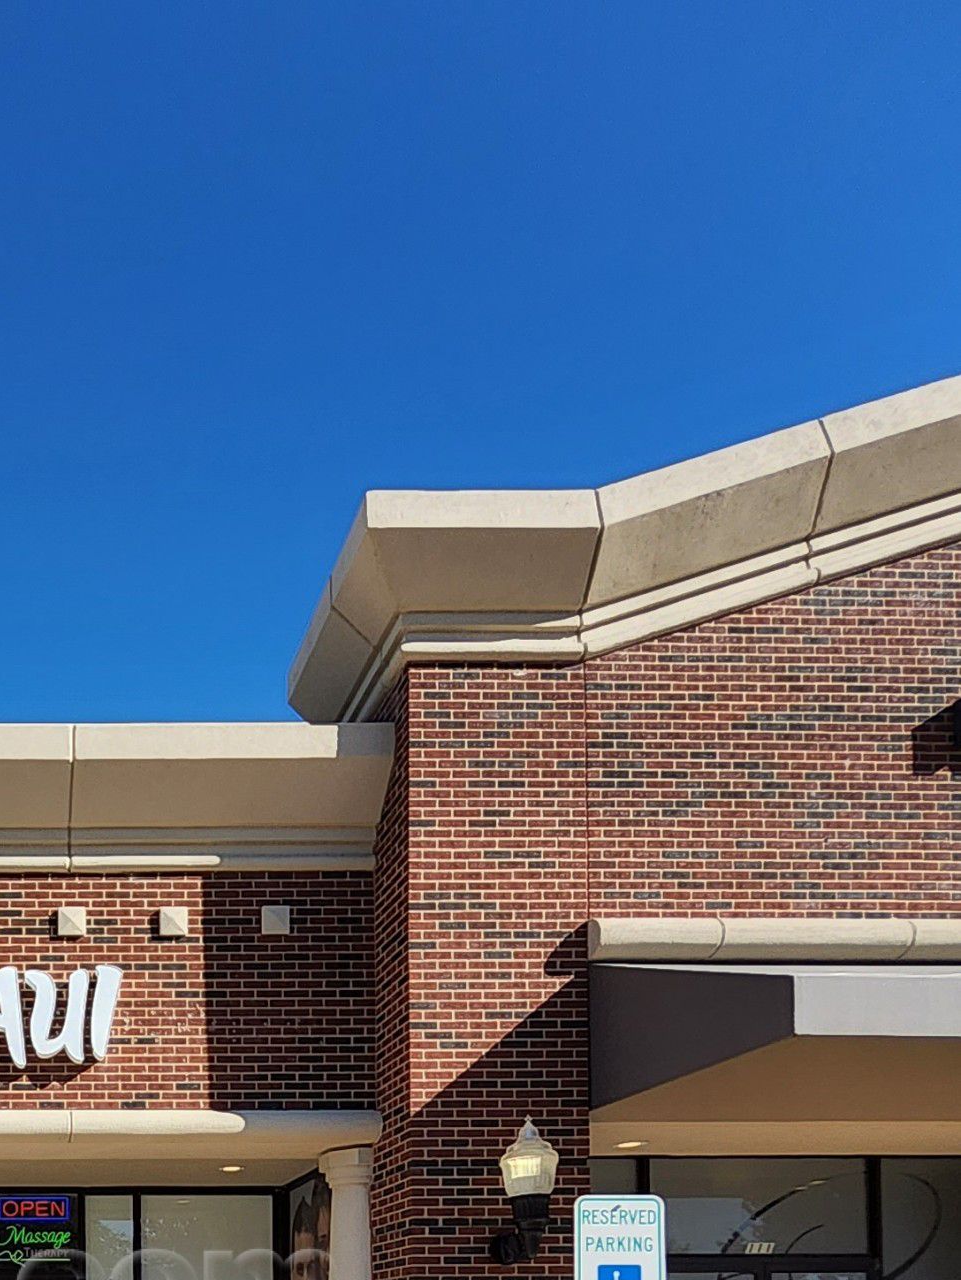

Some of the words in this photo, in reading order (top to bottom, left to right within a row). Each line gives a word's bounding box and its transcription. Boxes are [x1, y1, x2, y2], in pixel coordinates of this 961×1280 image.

[2, 1200, 65, 1217] OPEN
[581, 1209, 657, 1225] RESERVED
[585, 1236, 654, 1253] PARKING
